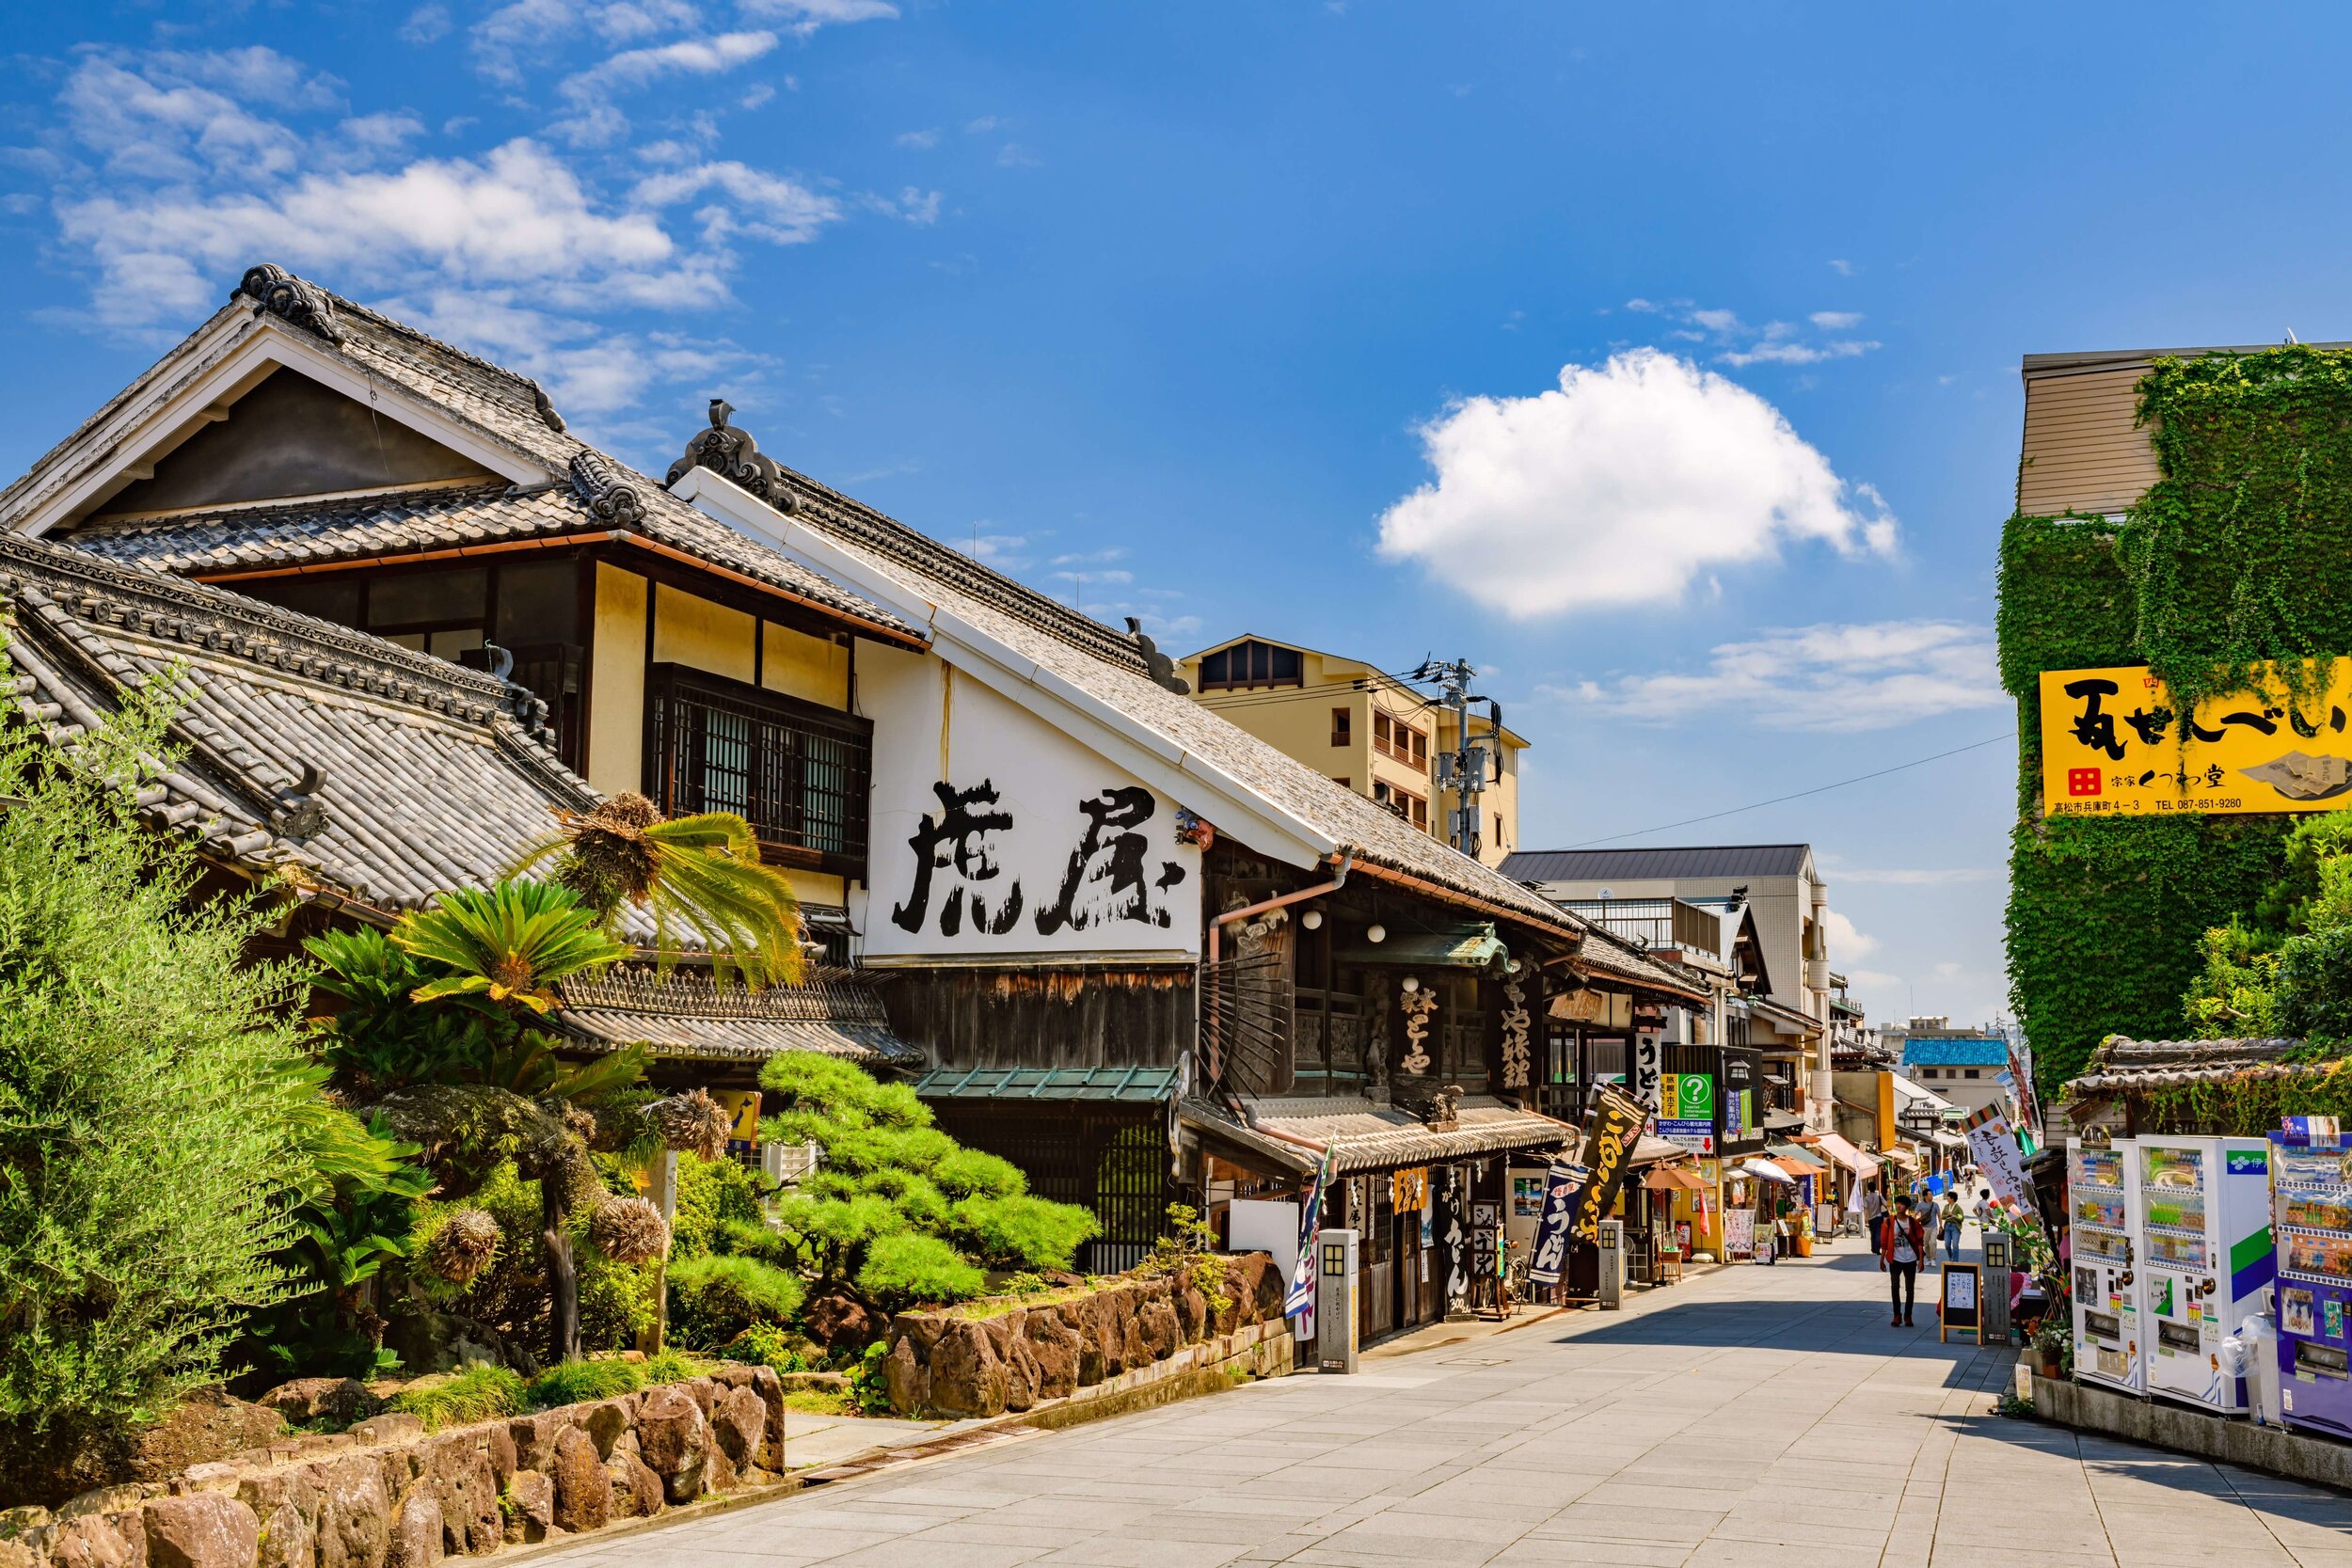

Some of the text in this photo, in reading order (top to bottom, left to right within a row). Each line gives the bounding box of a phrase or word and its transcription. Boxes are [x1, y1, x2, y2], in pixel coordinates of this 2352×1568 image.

[2155, 800, 2174, 811] TEL
[2177, 798, 2242, 810] 087-851-9280
[892, 778, 1186, 937] 虎屋
